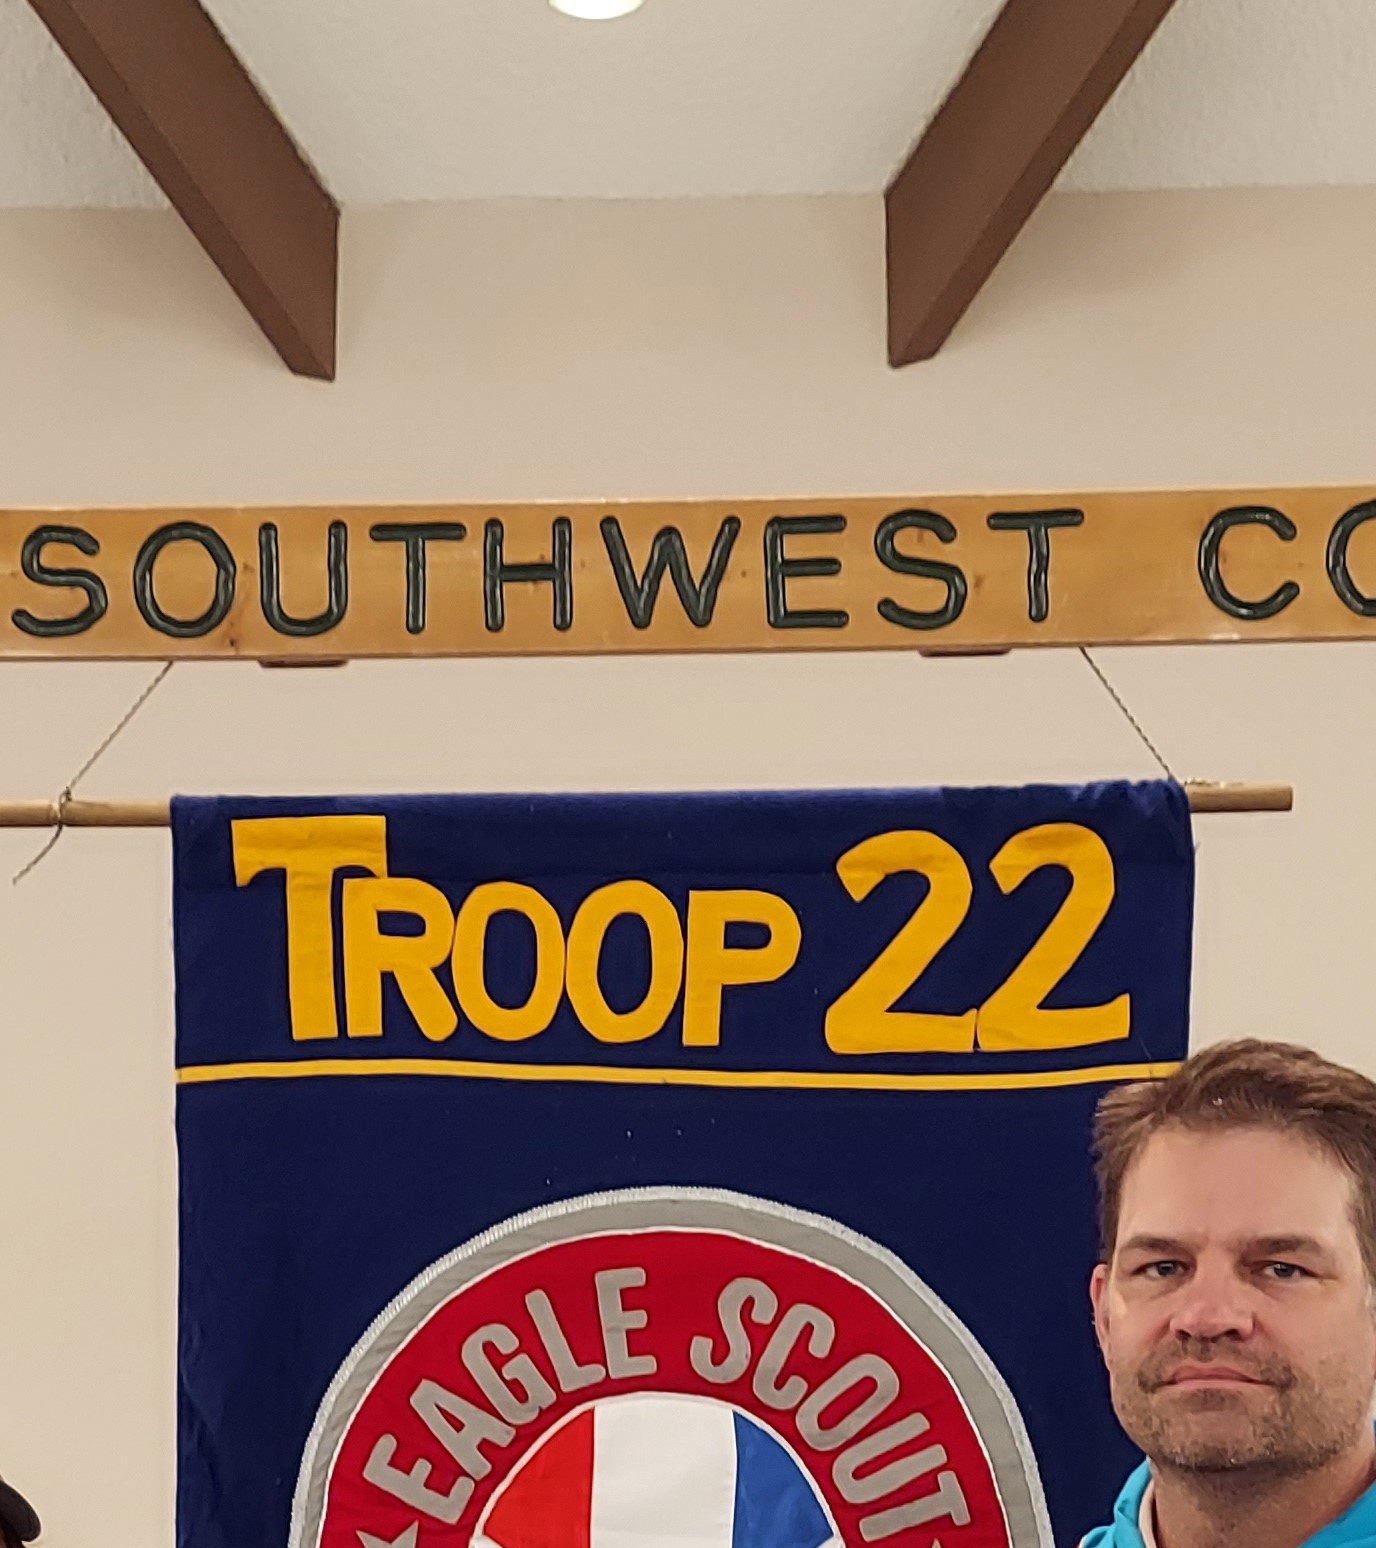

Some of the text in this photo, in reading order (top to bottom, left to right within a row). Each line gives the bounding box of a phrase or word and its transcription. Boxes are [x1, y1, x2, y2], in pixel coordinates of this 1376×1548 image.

[11, 507, 1085, 640] SOUTHWEST
[230, 814, 1131, 1054] TROOP 22
[361, 1266, 972, 1543] EAGLE SCOUT
